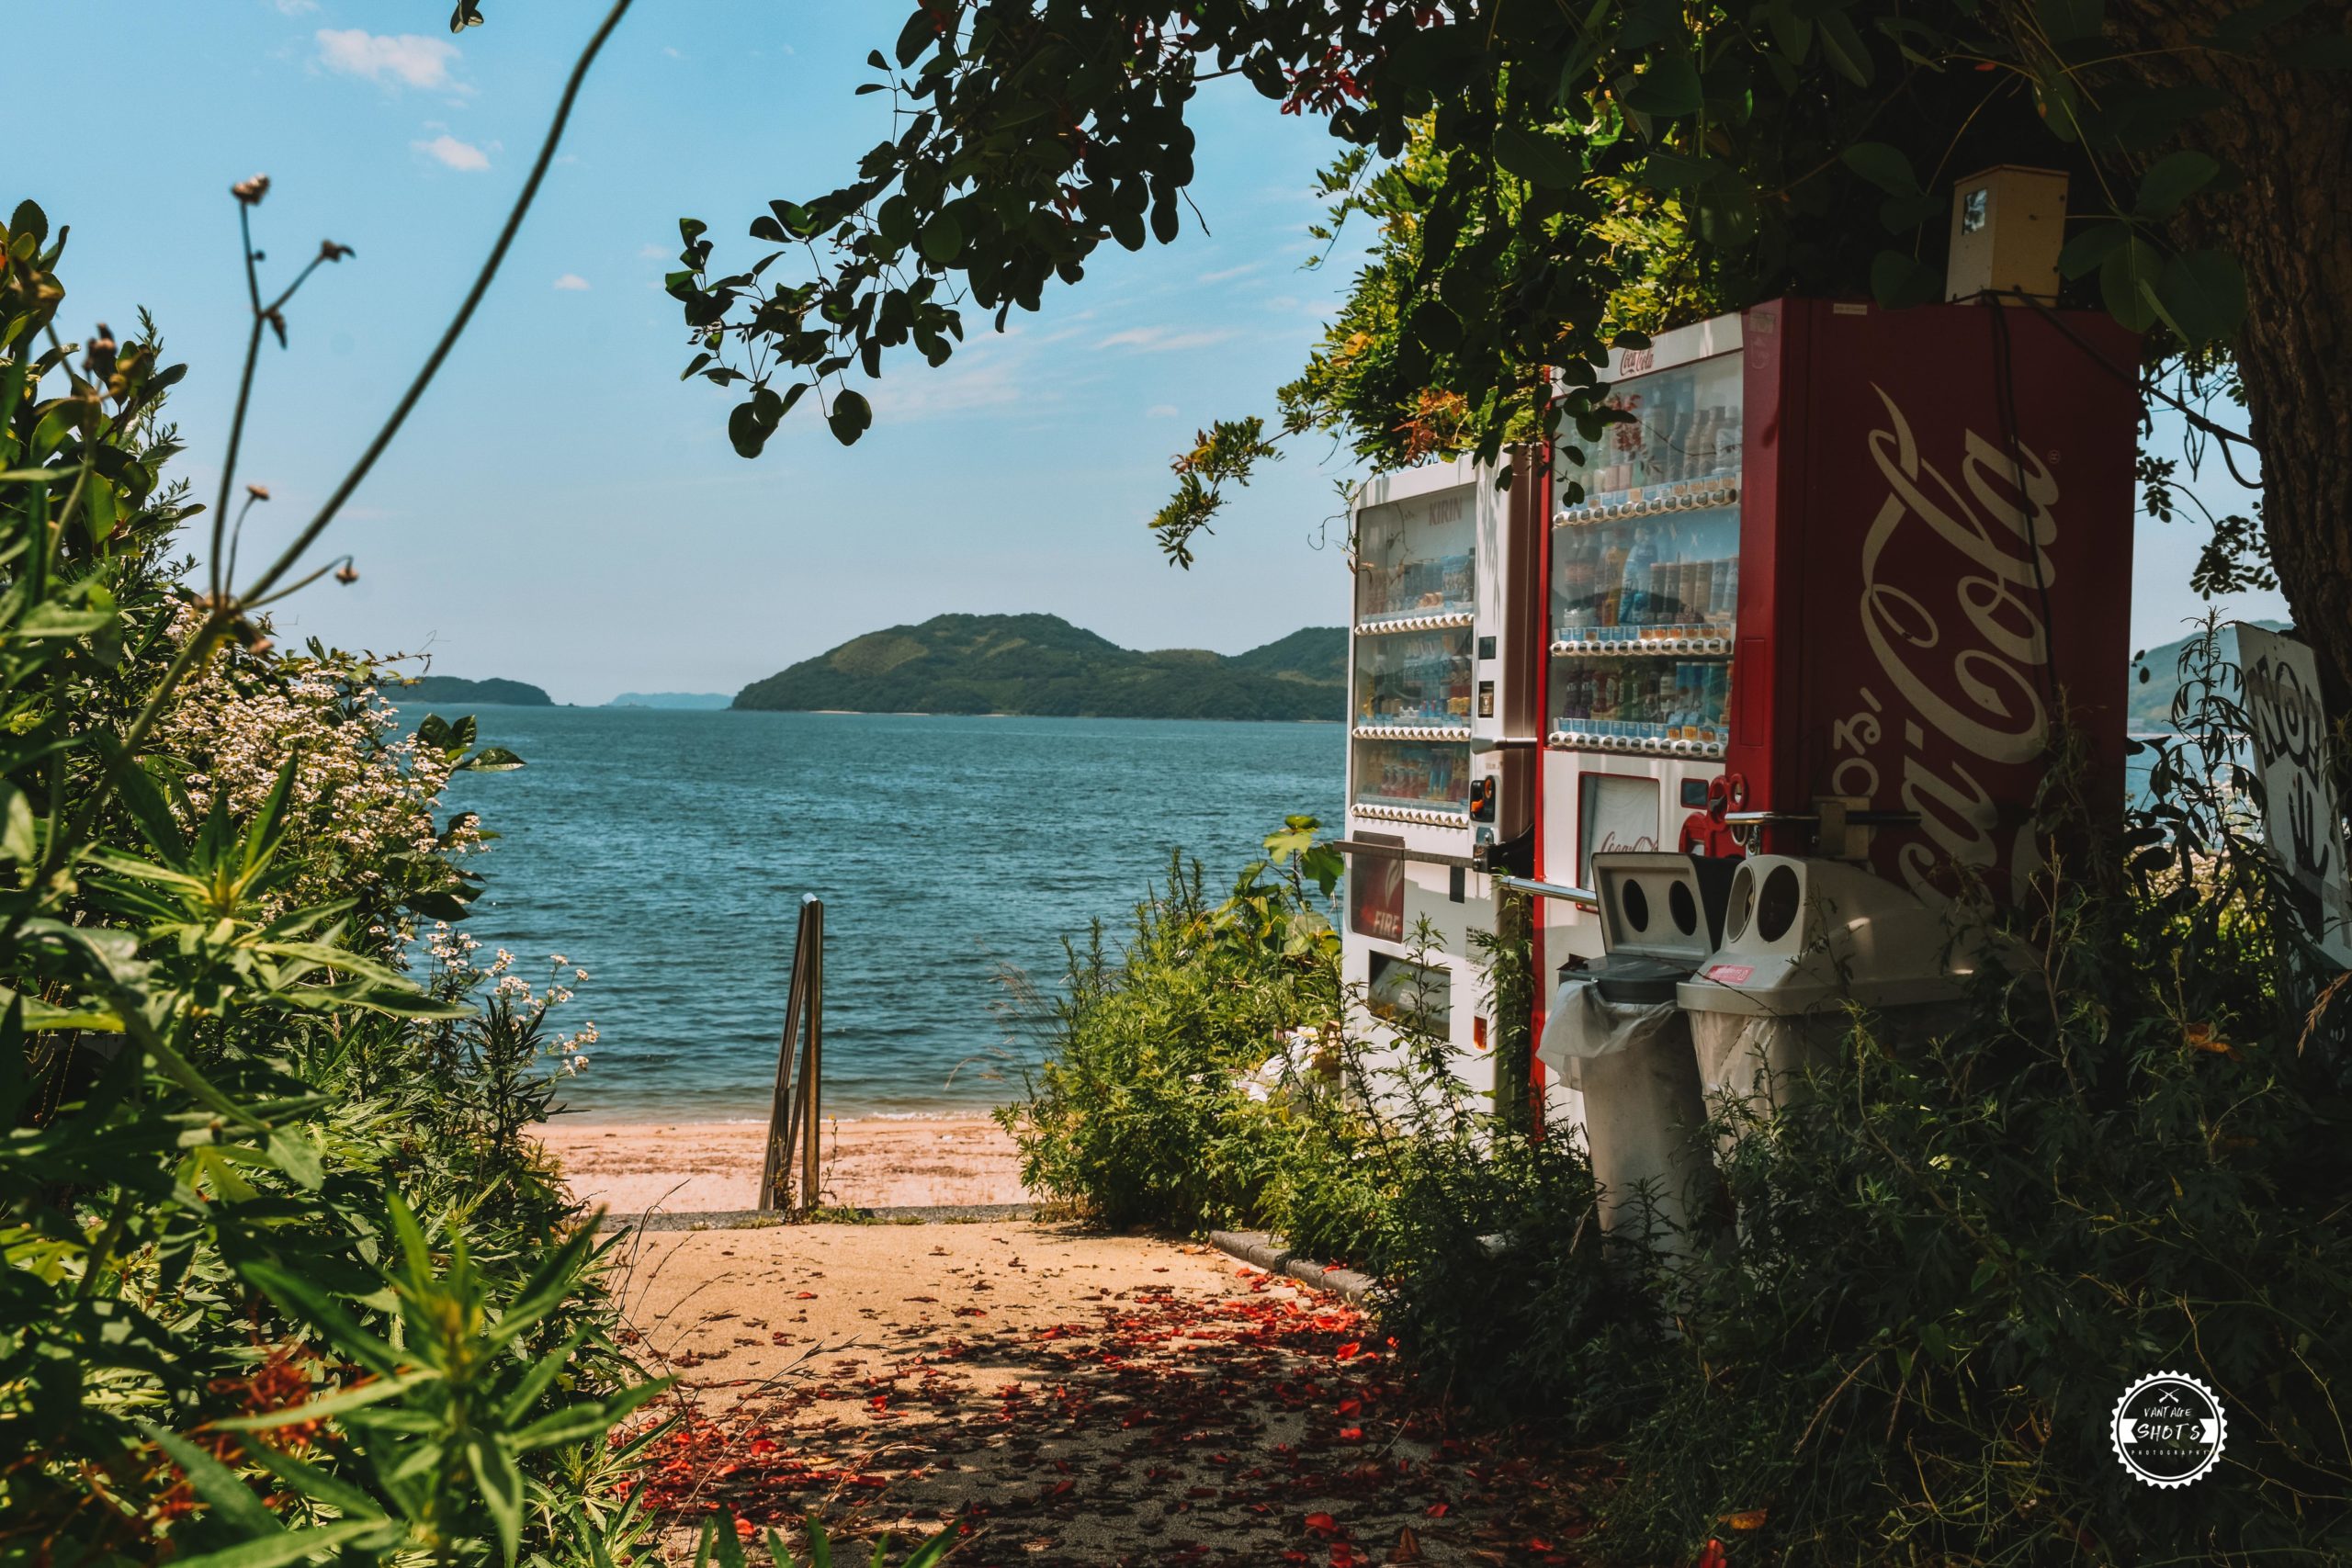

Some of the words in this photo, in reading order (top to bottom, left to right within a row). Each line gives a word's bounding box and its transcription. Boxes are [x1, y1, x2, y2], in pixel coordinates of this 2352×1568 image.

[1429, 496, 1463, 526] KIRIN
[1860, 381, 2059, 908] ca-Cola
[1373, 910, 1401, 938] FIRE
